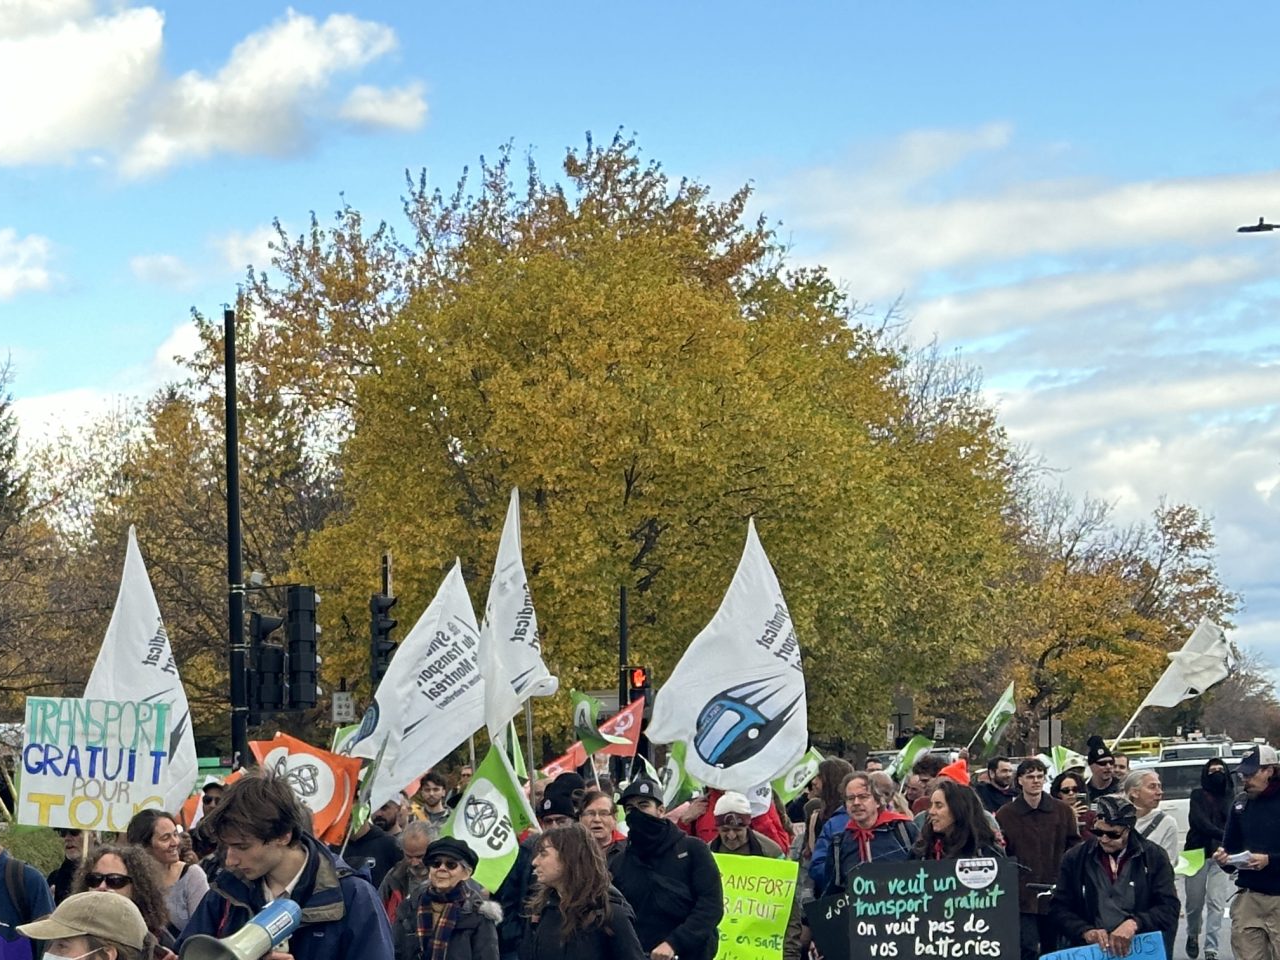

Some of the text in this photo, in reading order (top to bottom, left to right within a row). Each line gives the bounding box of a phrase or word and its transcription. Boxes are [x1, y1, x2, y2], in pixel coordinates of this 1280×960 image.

[27, 699, 171, 752] TRANSPORT
[23, 743, 167, 785] GRATUIT
[72, 777, 130, 804] POUR
[486, 814, 513, 851] CSN
[720, 873, 794, 898] ANSPORT
[853, 876, 876, 895] On
[888, 867, 929, 895] veut
[933, 875, 957, 892] un
[723, 896, 785, 921] RATUIT
[853, 884, 1005, 919] transport gratuit
[885, 914, 920, 935] veut
[928, 918, 955, 941] pas
[963, 914, 990, 934] de
[870, 936, 1001, 958] vos batteries
